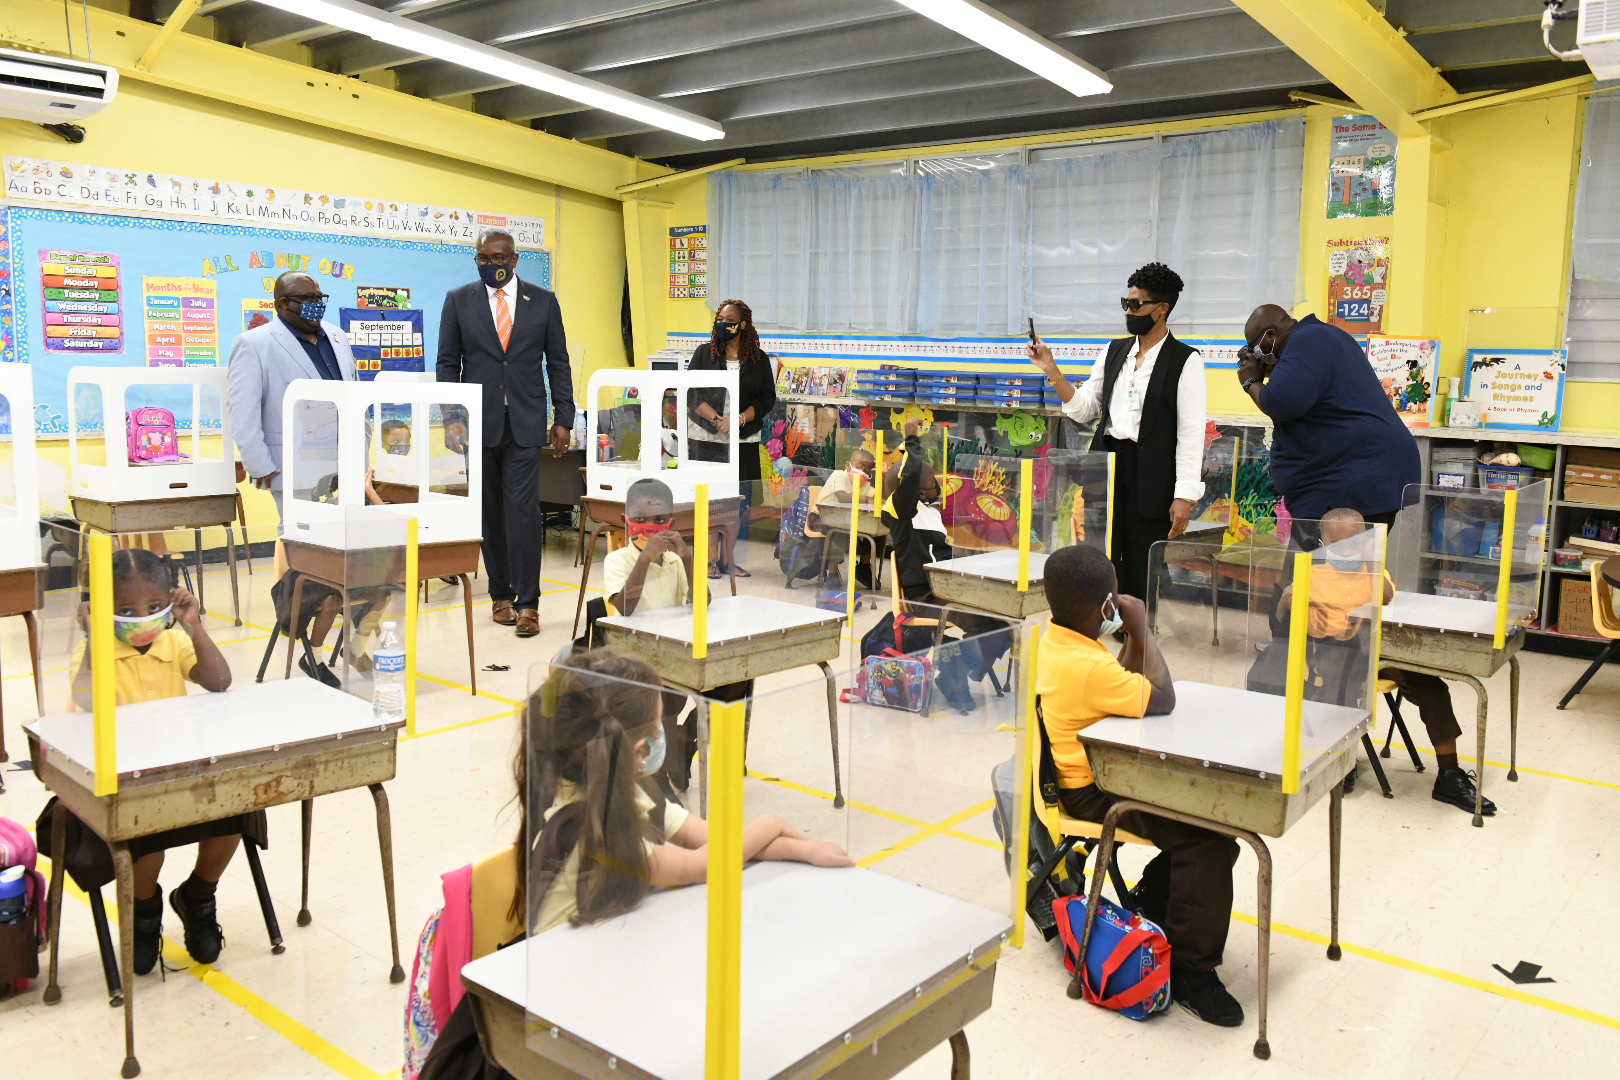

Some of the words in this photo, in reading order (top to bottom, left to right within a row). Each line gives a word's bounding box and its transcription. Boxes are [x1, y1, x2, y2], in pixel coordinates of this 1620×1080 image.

[1334, 124, 1350, 133] The
[1352, 123, 1376, 132] Same
[9, 180, 28, 192] Aa
[34, 182, 51, 195] Bb
[80, 186, 98, 200] Dd
[105, 189, 120, 202] Ee
[126, 192, 137, 204] Ff
[144, 194, 162, 208] Gg
[170, 197, 186, 210] Hh
[194, 198, 200, 210] Ii
[210, 200, 218, 215] Jj
[228, 202, 241, 214] Kk
[259, 206, 279, 218] Mm
[282, 208, 297, 220] Nn
[300, 210, 315, 222] Oo
[318, 212, 330, 225] Pp
[332, 214, 348, 227] Qq
[350, 215, 361, 226] Rr
[364, 216, 374, 228] Ss
[376, 218, 384, 228] Tt
[386, 219, 399, 231] Uu
[402, 220, 412, 231] Vv
[414, 222, 431, 233] Ww
[434, 224, 446, 235] Xx
[448, 225, 458, 237] Yy
[462, 226, 472, 237] Zz
[478, 216, 506, 226] Numbers
[64, 265, 97, 276] Sunday
[202, 255, 239, 277] ALL
[248, 251, 312, 272] ABOUT
[318, 258, 355, 281] OUR
[64, 278, 98, 289] Monday
[146, 282, 182, 292] Months
[192, 284, 214, 294] Year
[64, 290, 100, 300] Tuesday
[1343, 286, 1371, 299] 365
[149, 298, 178, 306] January
[57, 302, 108, 313] Wednesday
[1338, 303, 1369, 316] -124
[63, 314, 102, 325] Thursday
[360, 322, 404, 331] September
[69, 328, 97, 338] Friday
[64, 339, 103, 349] Saturday
[156, 337, 175, 345] April
[1495, 371, 1539, 381] Journey
[1491, 382, 1522, 392] Songs
[1493, 393, 1535, 403] Rhymes
[1575, 604, 1588, 613] for
